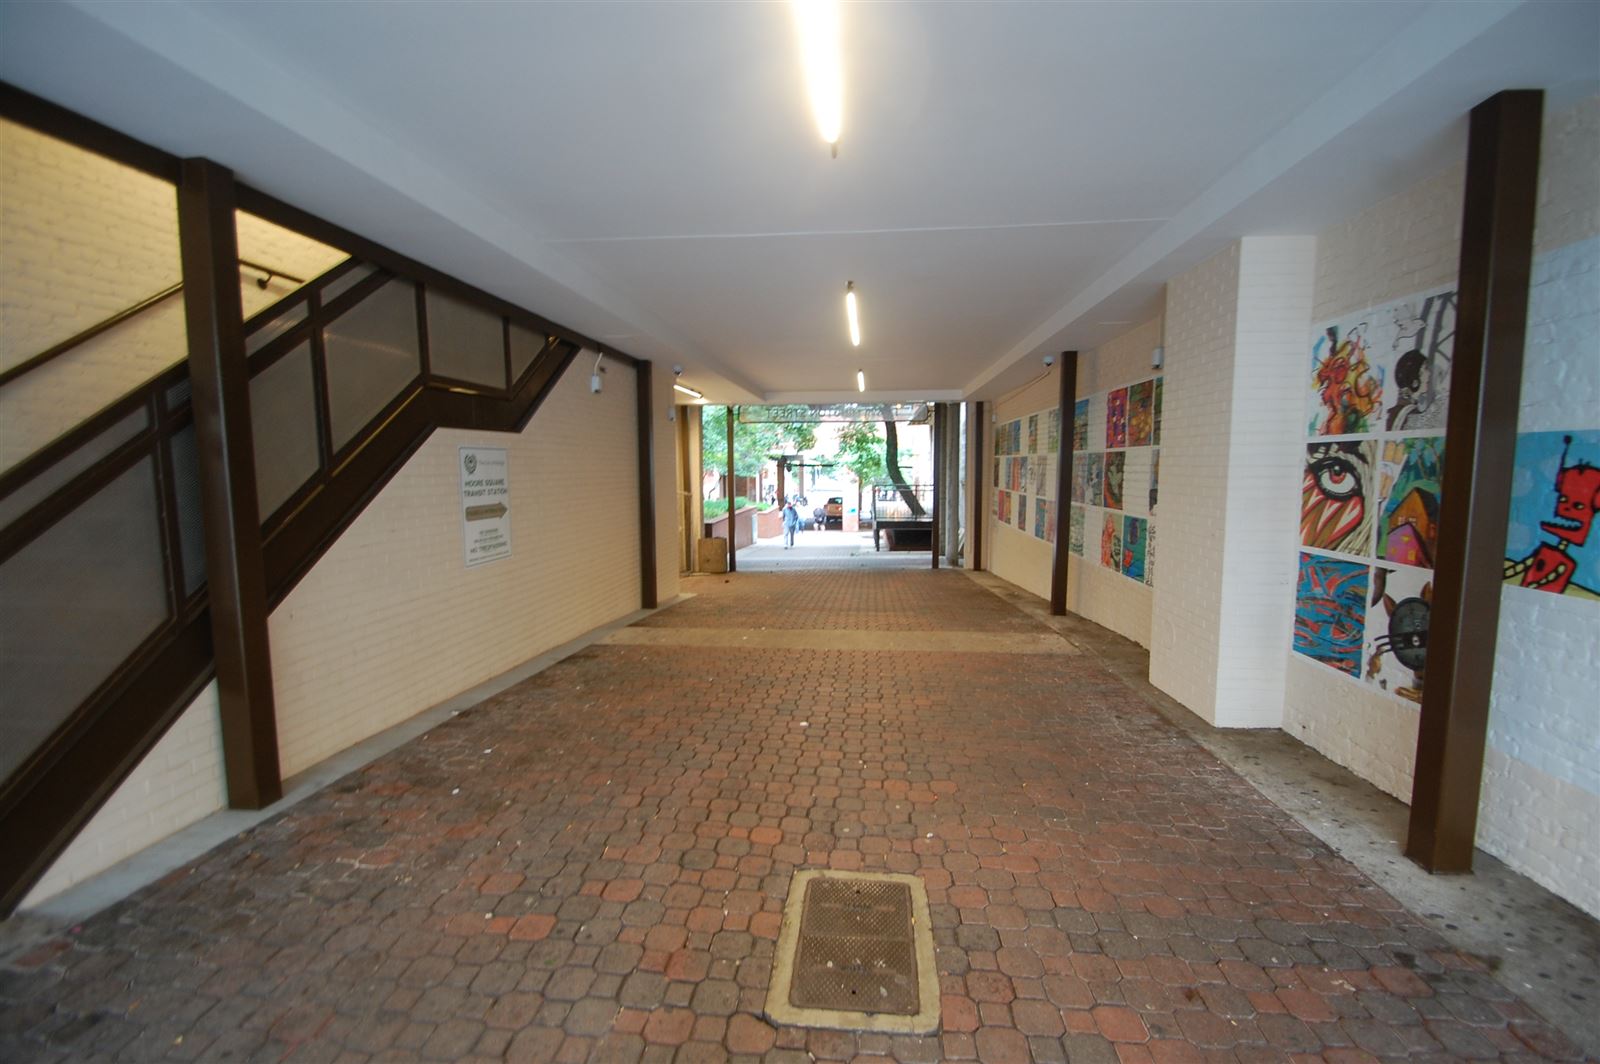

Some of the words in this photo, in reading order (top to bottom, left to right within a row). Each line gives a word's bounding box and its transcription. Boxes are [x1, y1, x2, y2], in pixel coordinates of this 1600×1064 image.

[464, 479, 483, 488] MOORE
[485, 478, 505, 487] SQUARE
[464, 489, 486, 497] TRANSIT
[487, 487, 508, 496] STATION
